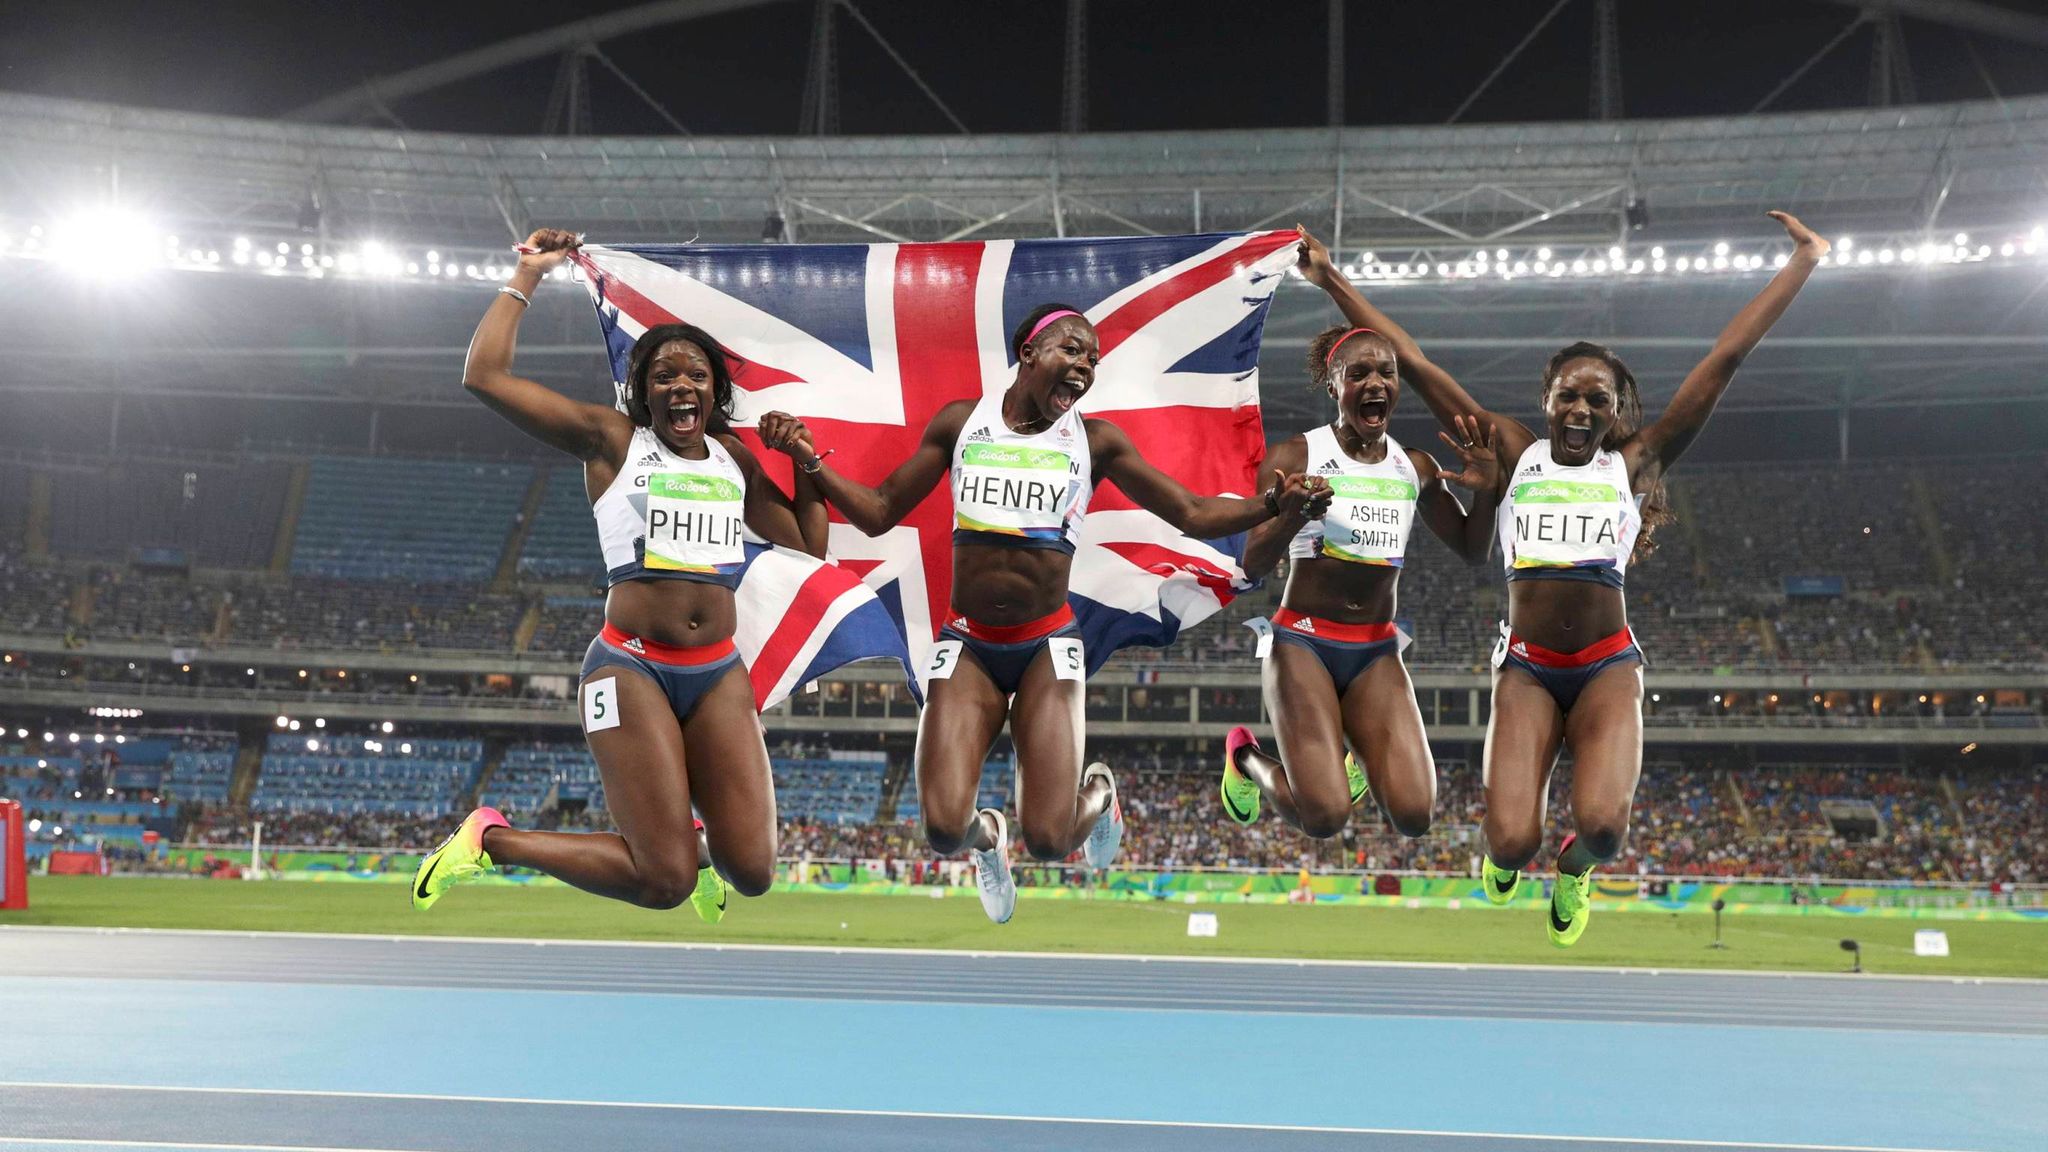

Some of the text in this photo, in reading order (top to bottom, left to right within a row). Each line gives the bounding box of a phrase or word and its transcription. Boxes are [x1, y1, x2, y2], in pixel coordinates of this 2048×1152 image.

[637, 459, 668, 468] adidas
[665, 479, 710, 493] Rio2016
[960, 476, 1066, 513] HENRY
[1350, 505, 1399, 525] ASHER
[649, 509, 741, 547] PHILIP
[1350, 529, 1398, 549] SMITH
[1516, 514, 1616, 545] NEITA
[931, 649, 950, 670] 5
[1067, 646, 1080, 670] 5
[593, 691, 605, 720] 5
